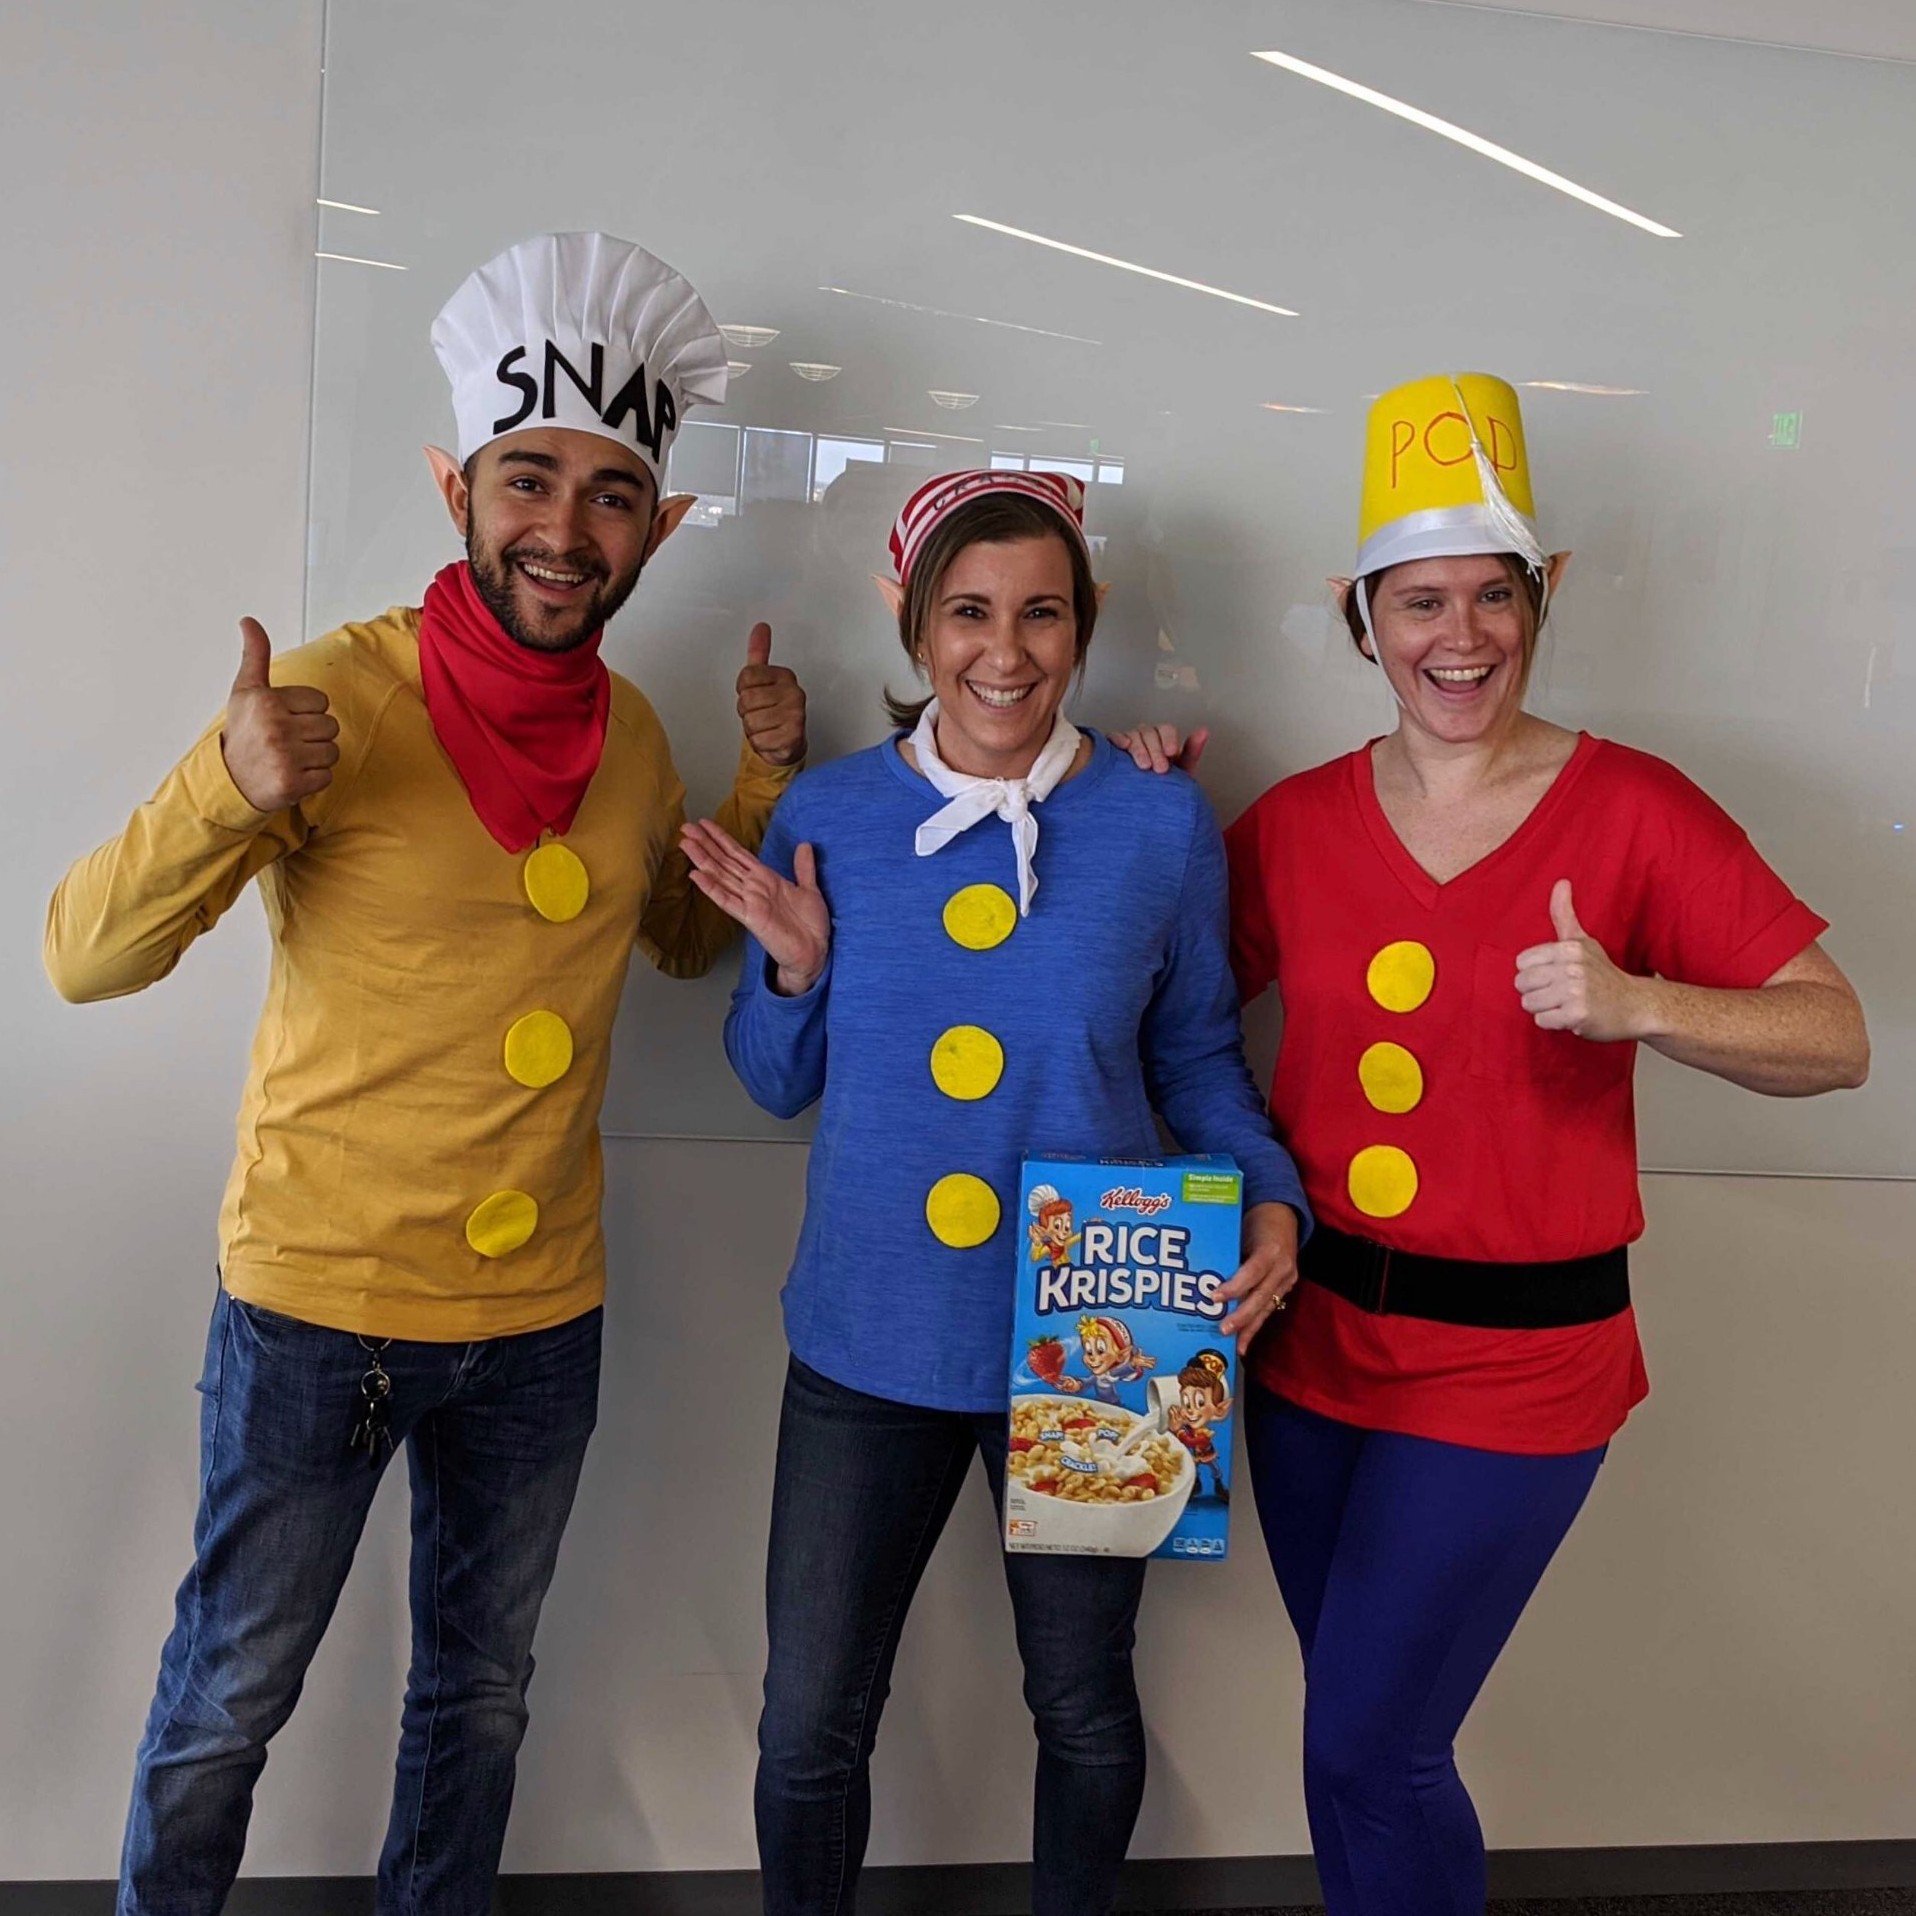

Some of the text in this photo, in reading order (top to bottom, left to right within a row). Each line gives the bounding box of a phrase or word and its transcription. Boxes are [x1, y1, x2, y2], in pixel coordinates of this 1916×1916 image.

[493, 338, 677, 464] SNAP
[1101, 1187, 1171, 1214] Kellogg's
[1084, 1225, 1187, 1268] RICE
[1038, 1266, 1225, 1317] KRISPIES
